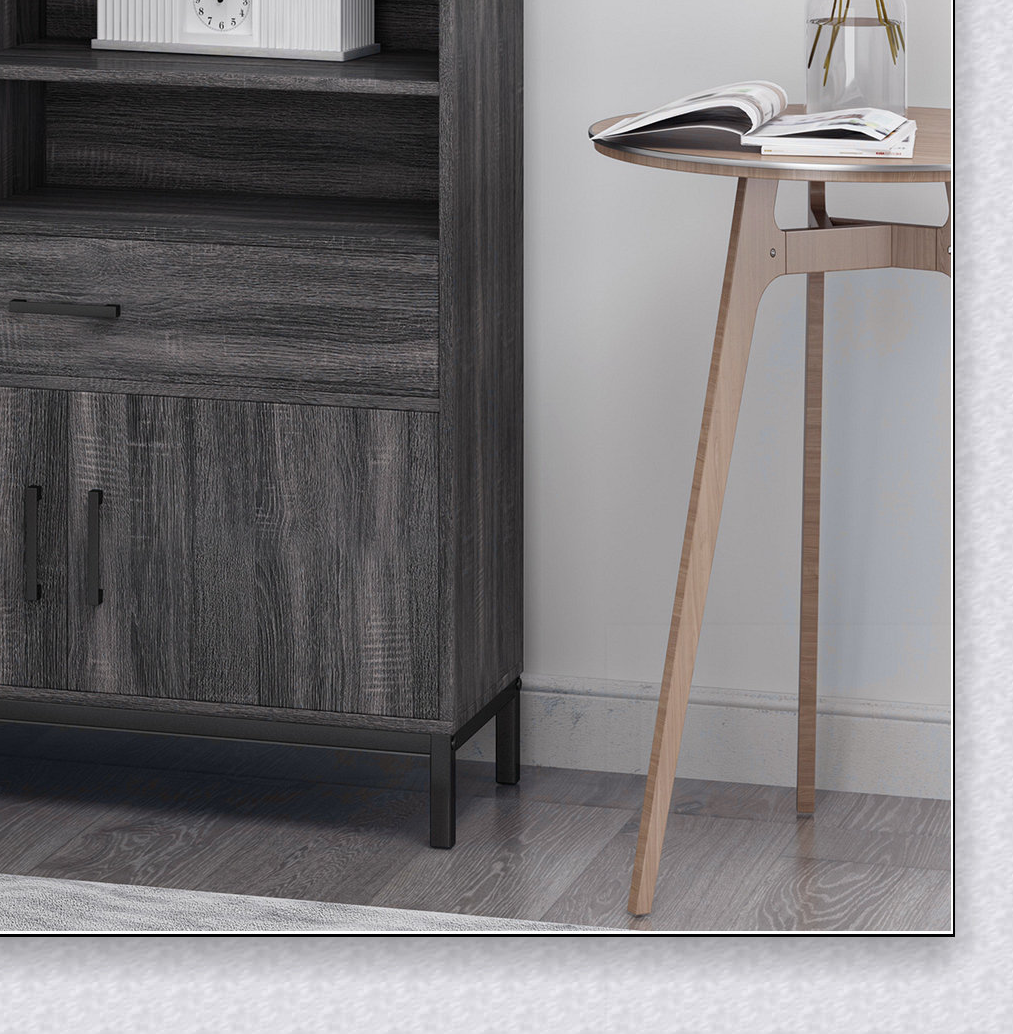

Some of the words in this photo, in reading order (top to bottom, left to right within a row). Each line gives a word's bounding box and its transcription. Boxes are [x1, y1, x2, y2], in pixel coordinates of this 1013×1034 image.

[198, 7, 204, 15] 8
[207, 16, 213, 25] 7
[230, 17, 236, 26] 5
[218, 21, 225, 30] 6
